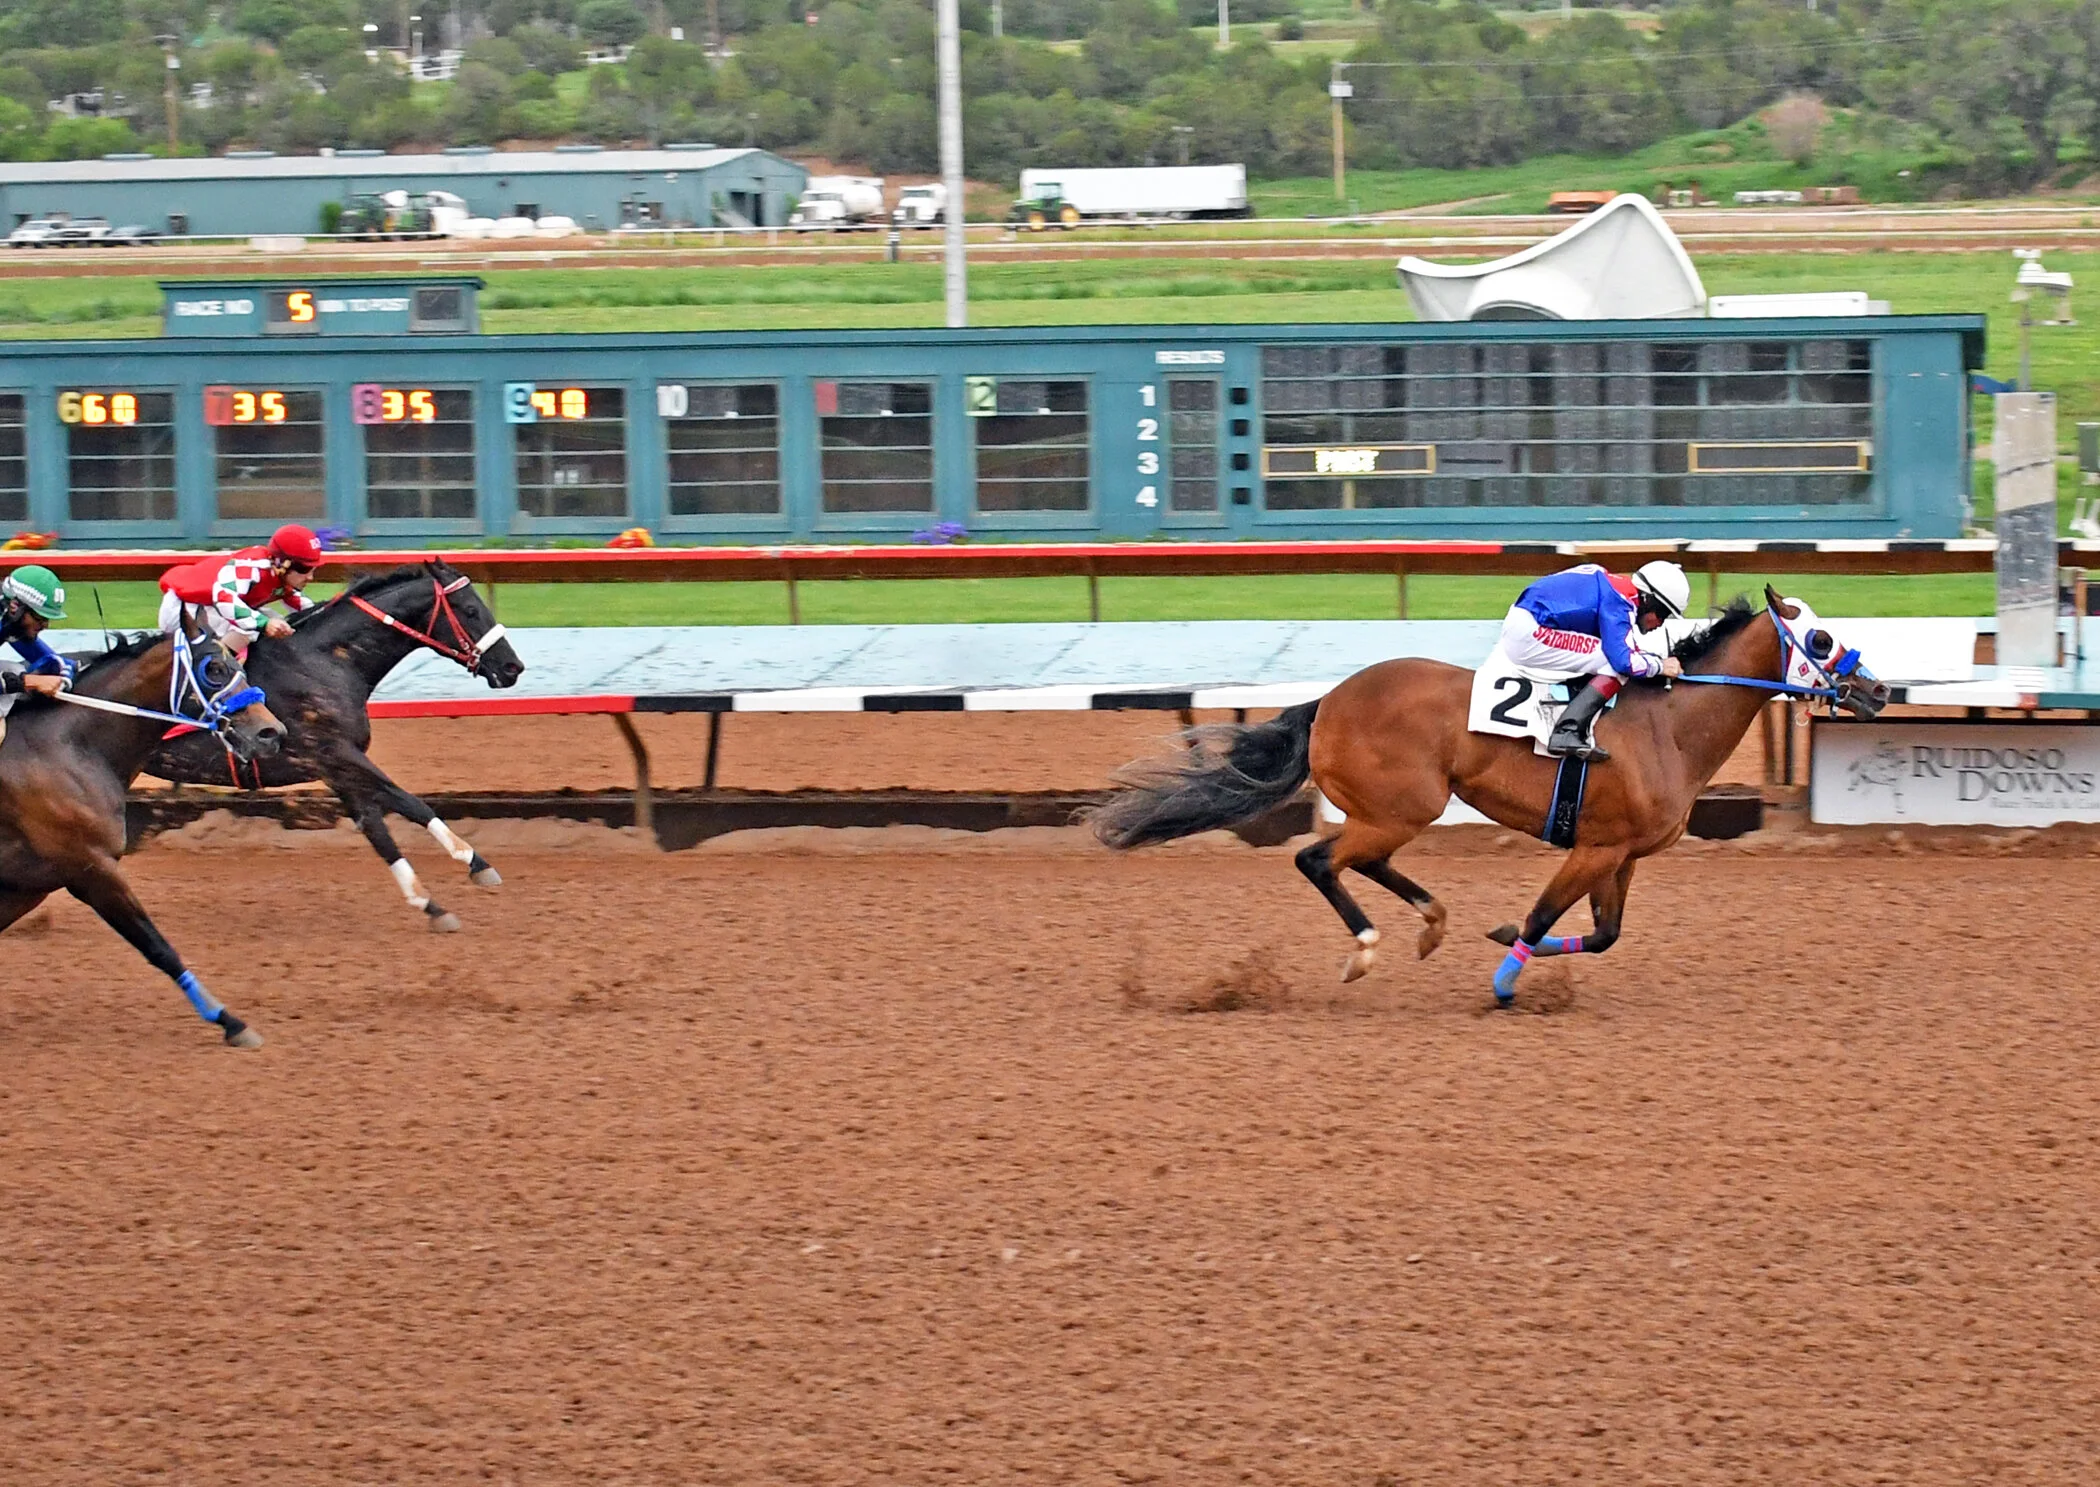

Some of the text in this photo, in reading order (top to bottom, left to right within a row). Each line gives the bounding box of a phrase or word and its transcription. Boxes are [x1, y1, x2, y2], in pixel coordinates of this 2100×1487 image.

[288, 291, 316, 322] 5
[57, 391, 83, 424] 6
[231, 391, 286, 422] 35
[381, 390, 435, 421] 35
[656, 384, 689, 417] 10
[1138, 385, 1156, 407] 1
[1136, 418, 1159, 441] 2
[1136, 452, 1159, 474] 3
[1135, 486, 1159, 507] 4
[1490, 676, 1533, 727] 2
[1911, 745, 2066, 778] RUIDOSO
[1957, 769, 2096, 802] DOWNS
